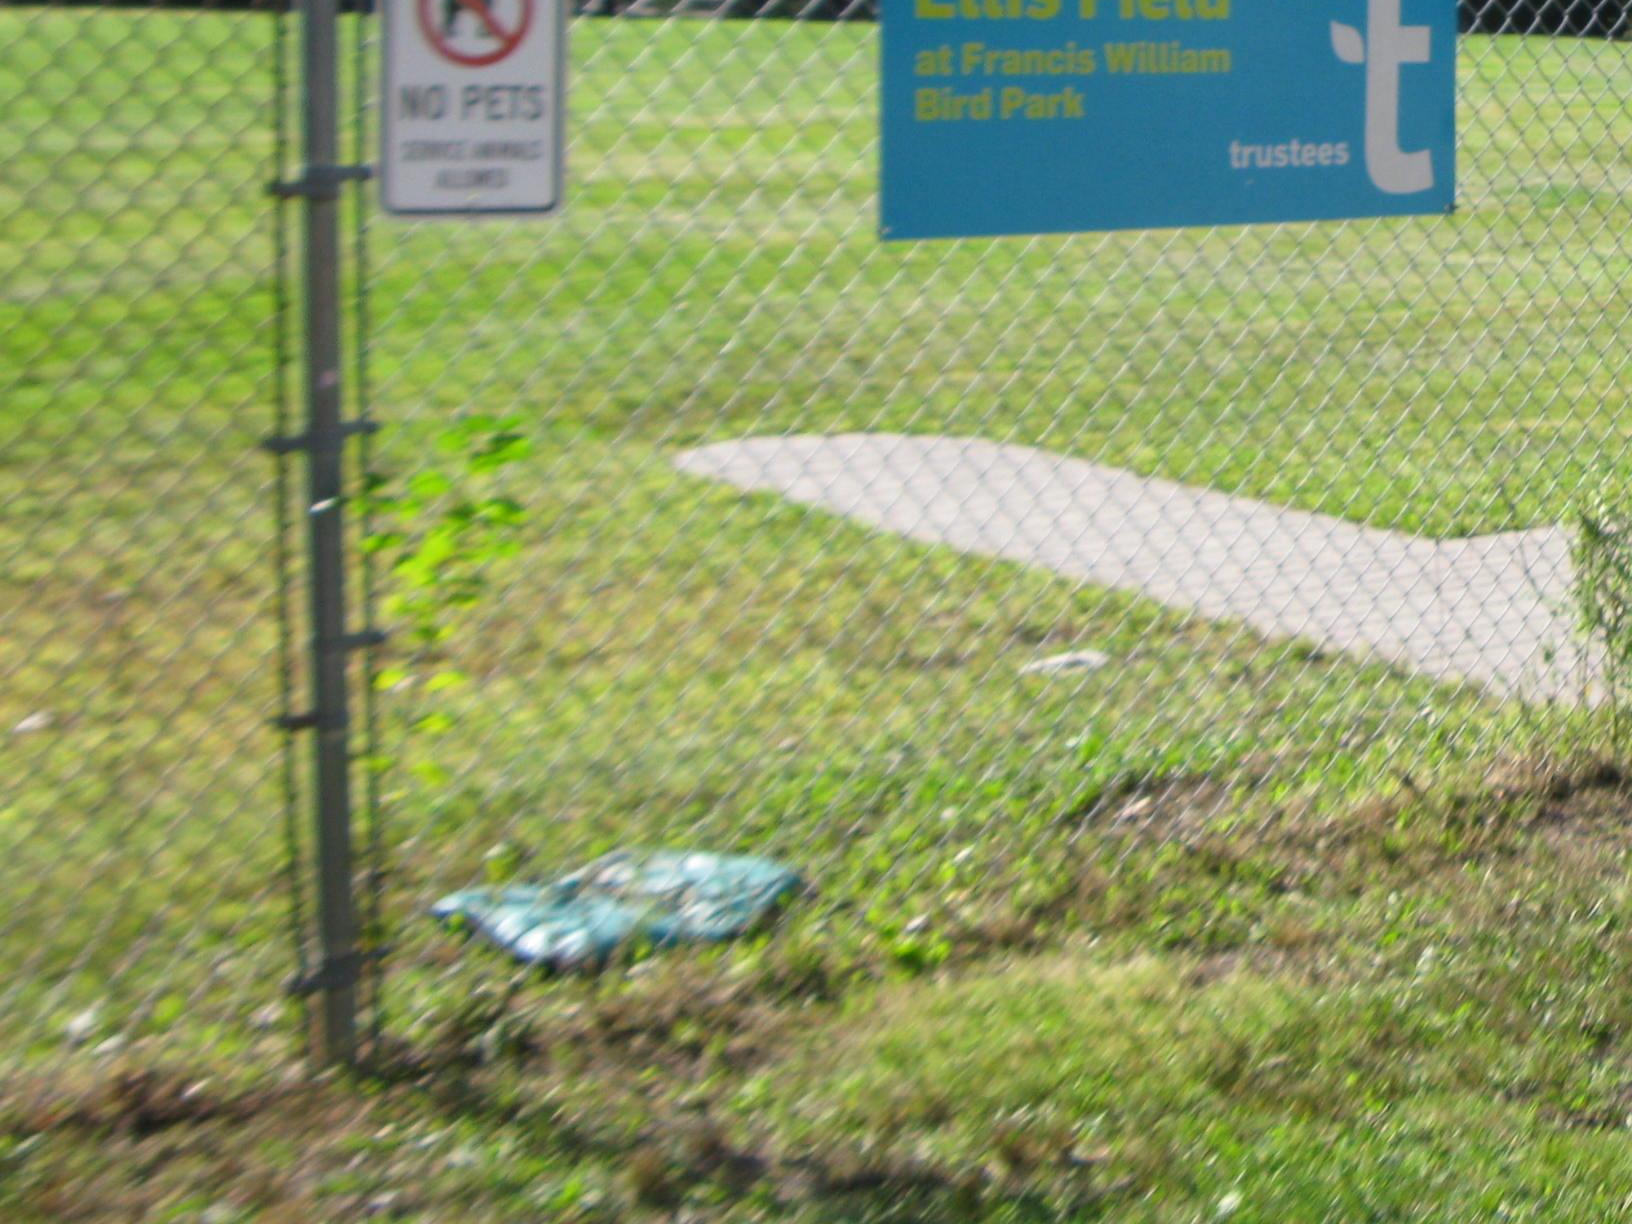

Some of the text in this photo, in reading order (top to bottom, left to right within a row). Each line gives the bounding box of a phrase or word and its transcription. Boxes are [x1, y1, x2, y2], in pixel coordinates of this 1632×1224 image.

[914, 41, 1231, 76] at Francis William
[399, 84, 545, 121] NO PETS
[914, 87, 1085, 120] Bird Park
[1230, 140, 1350, 169] trustees
